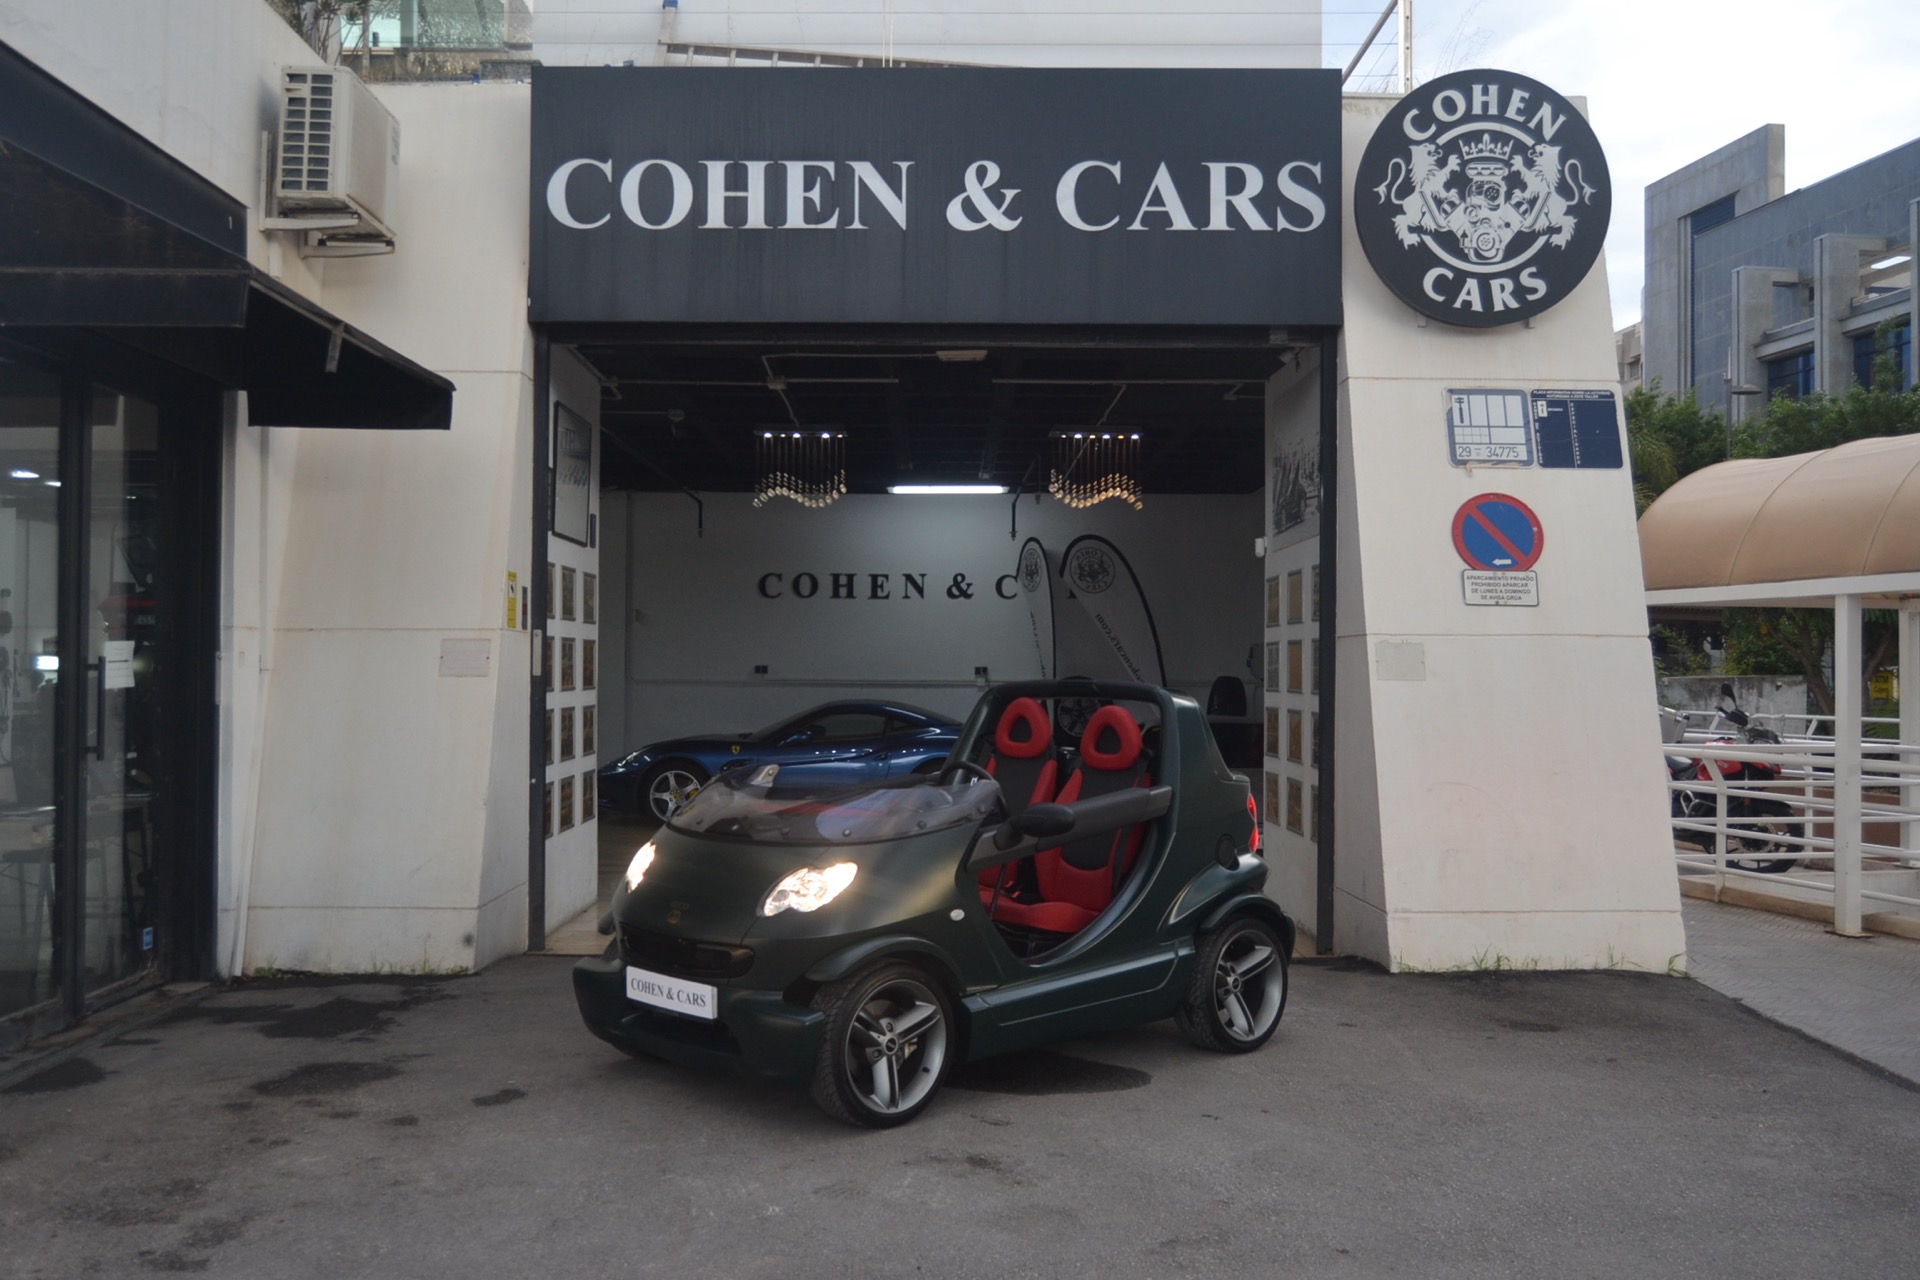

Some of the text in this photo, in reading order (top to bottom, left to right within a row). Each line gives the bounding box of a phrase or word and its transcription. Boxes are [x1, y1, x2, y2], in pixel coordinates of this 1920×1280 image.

[1403, 84, 1567, 141] COHEN
[547, 158, 1326, 232] COHEN & CARS
[1422, 266, 1547, 312] CARS
[1458, 446, 1472, 457] 29
[1486, 446, 1519, 458] 34775
[758, 572, 927, 600] COHEN
[945, 572, 974, 600] &
[630, 977, 706, 1008] COHEN & CARS
